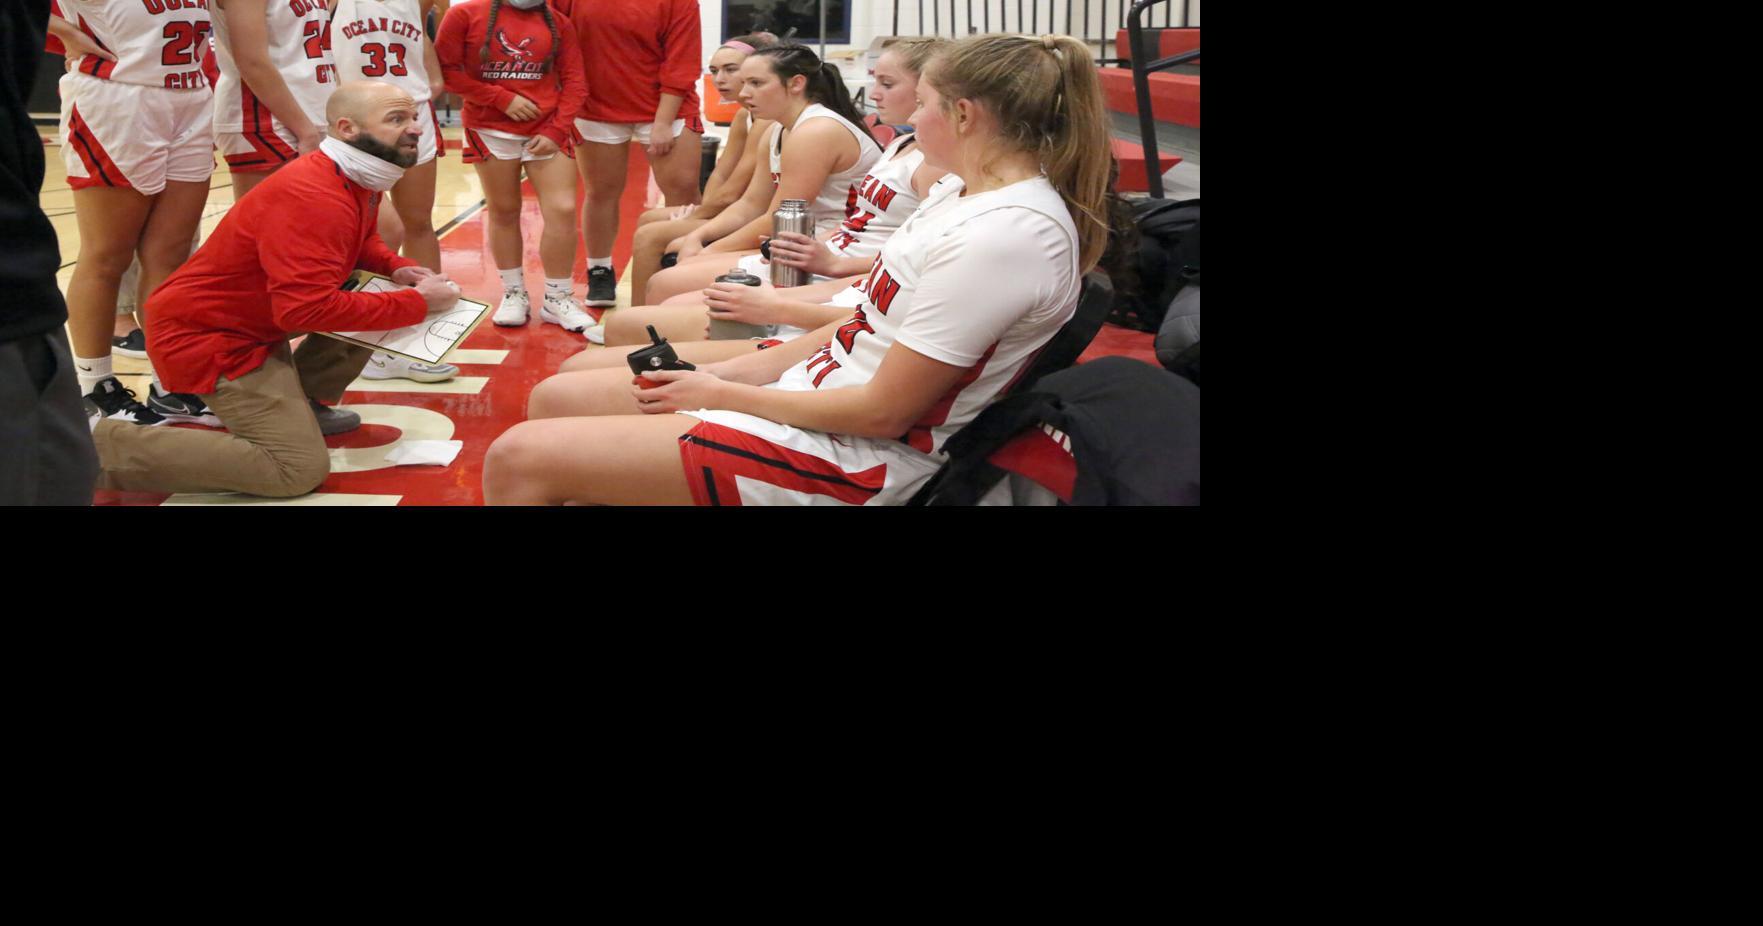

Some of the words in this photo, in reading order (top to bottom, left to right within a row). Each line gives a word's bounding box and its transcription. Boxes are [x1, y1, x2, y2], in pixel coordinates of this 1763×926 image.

[342, 17, 388, 40] OCEAN
[391, 19, 421, 42] CITY
[360, 42, 408, 77] 33
[482, 71, 501, 80] RED
[500, 71, 544, 80] RAIDERS
[859, 174, 898, 213] EAN
